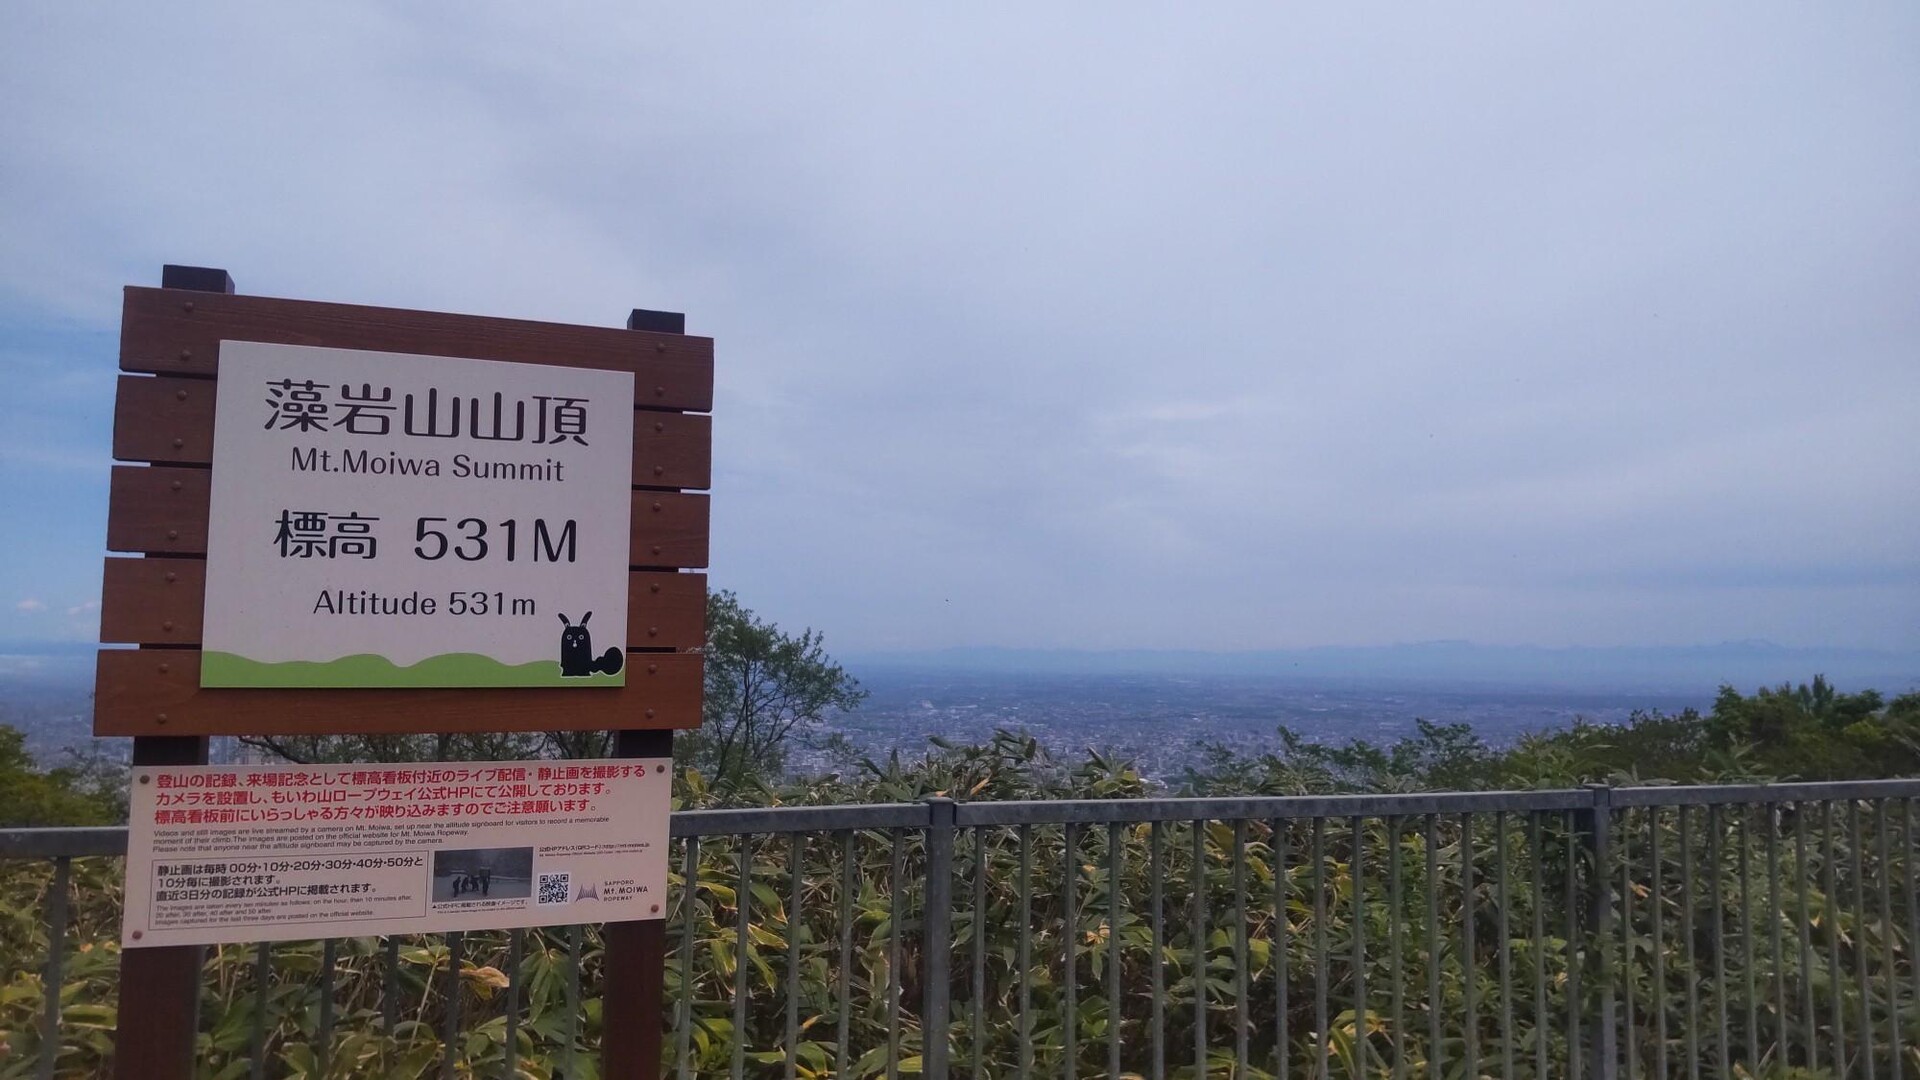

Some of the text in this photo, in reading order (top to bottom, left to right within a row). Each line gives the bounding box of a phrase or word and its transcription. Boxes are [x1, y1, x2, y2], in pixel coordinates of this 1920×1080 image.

[264, 378, 590, 446] 藻岩山山頂
[291, 447, 565, 482] Mt.Moiwa Summit
[273, 509, 577, 563] 標高 531M
[313, 590, 536, 616] Altitude 531m
[472, 821, 503, 829] signboard
[214, 844, 240, 852] anyone
[300, 841, 334, 849] signboard
[364, 839, 393, 847] captured
[249, 835, 275, 843] images
[290, 834, 313, 842] posted
[618, 885, 649, 894] MOIWA
